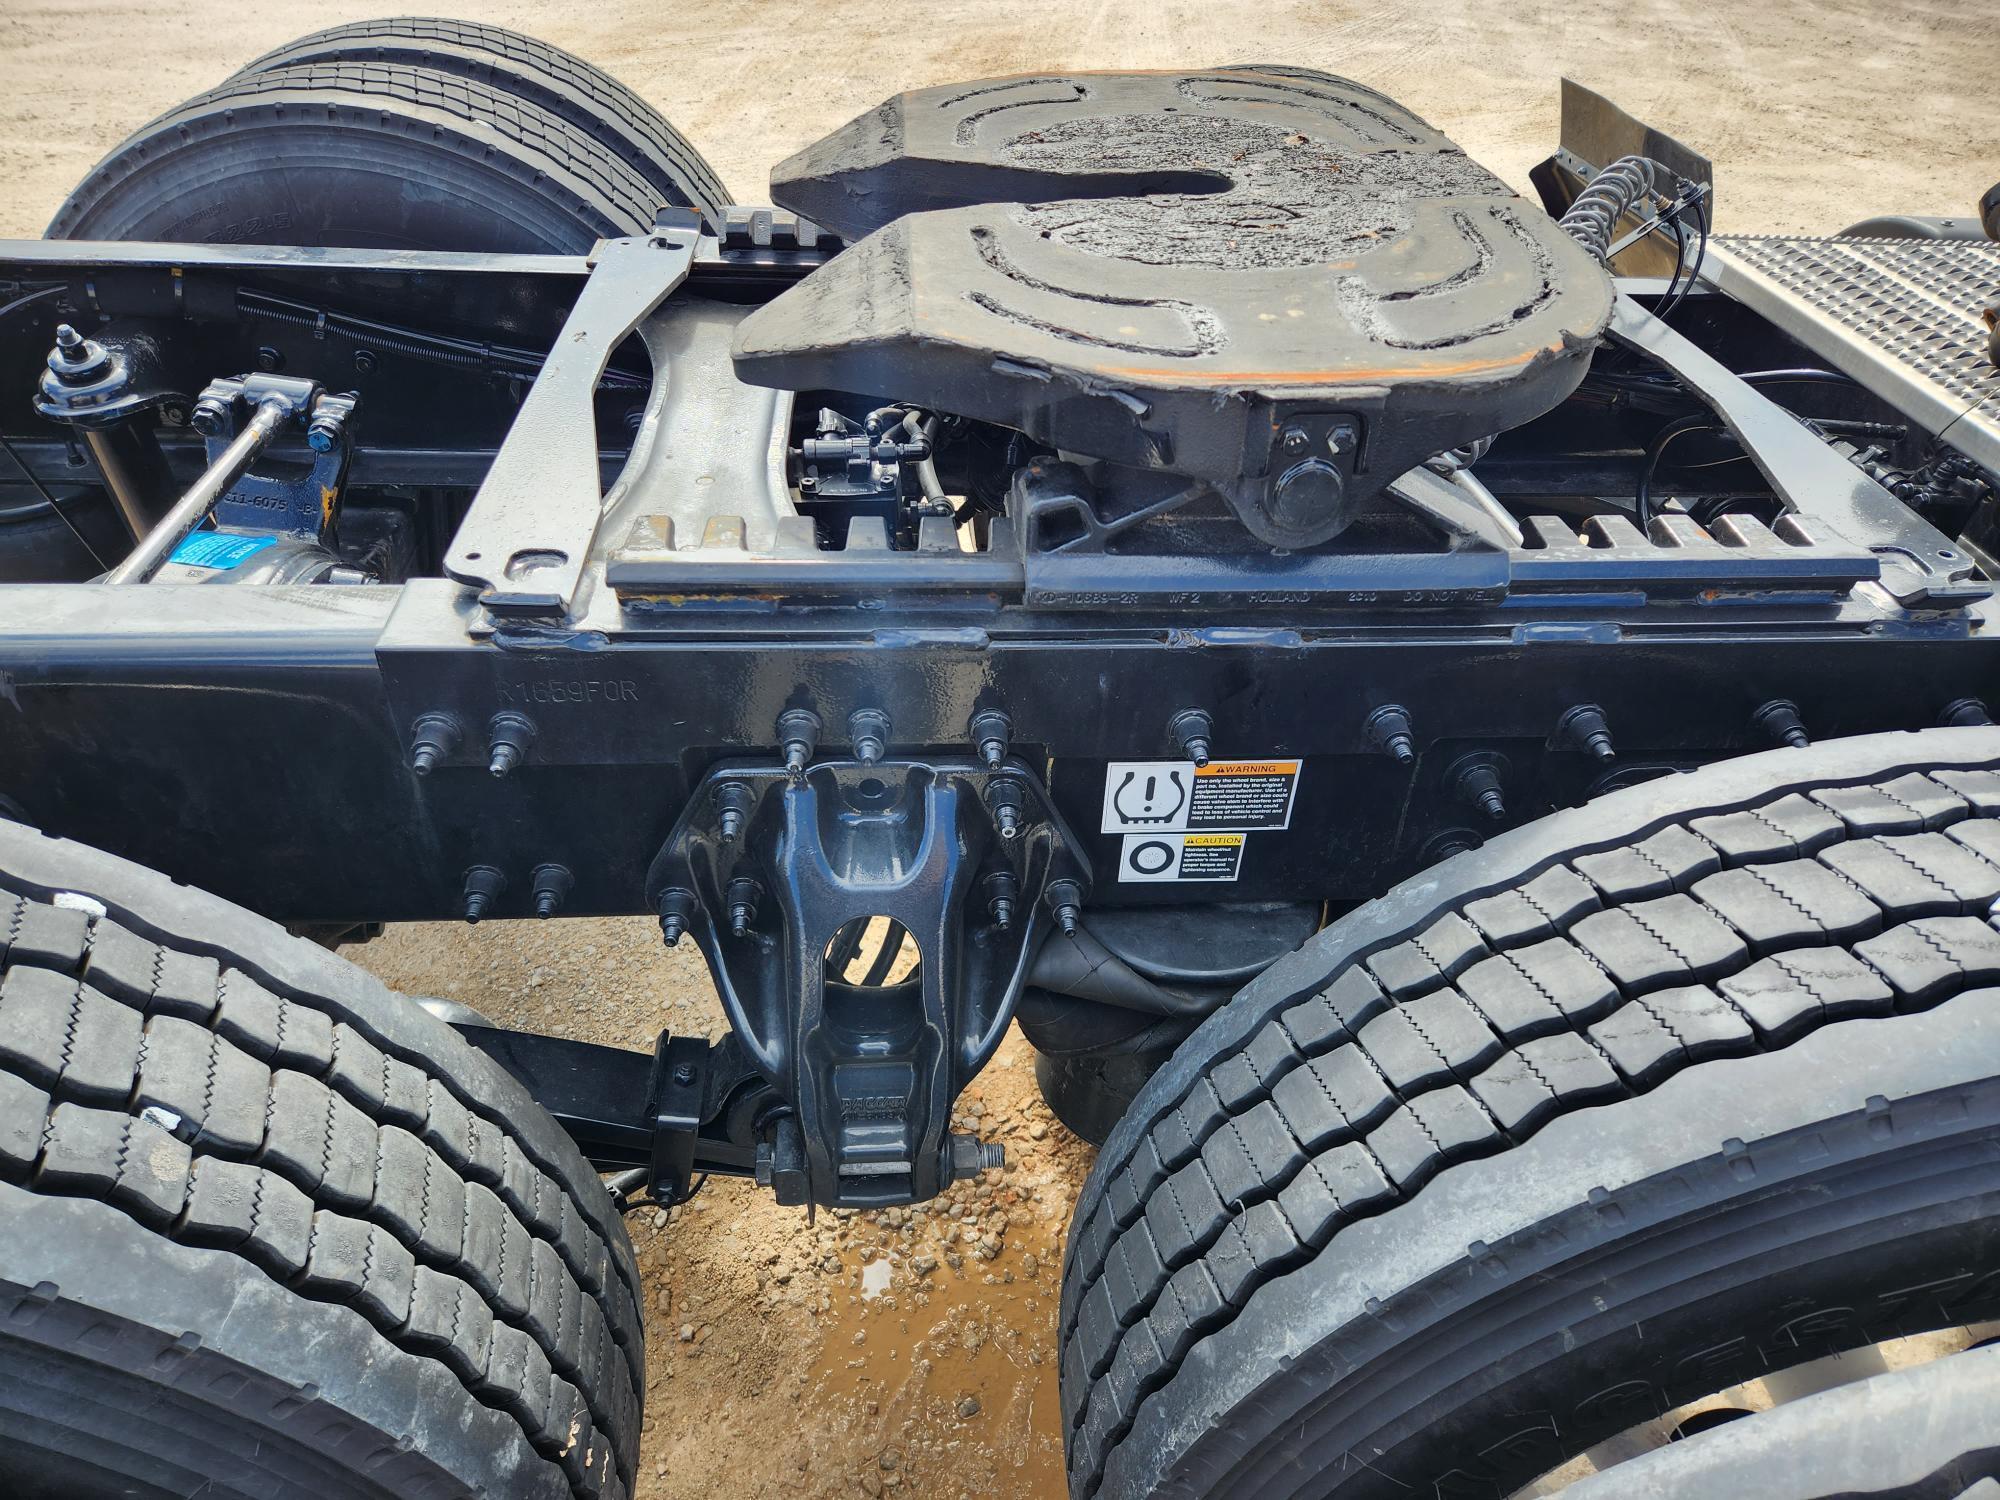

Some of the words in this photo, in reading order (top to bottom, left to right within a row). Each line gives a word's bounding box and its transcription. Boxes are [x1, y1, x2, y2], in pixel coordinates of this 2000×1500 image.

[1248, 592, 1310, 603] HOLLAND
[1429, 591, 1458, 602] NOT
[840, 1096, 906, 1110] PACCAR
